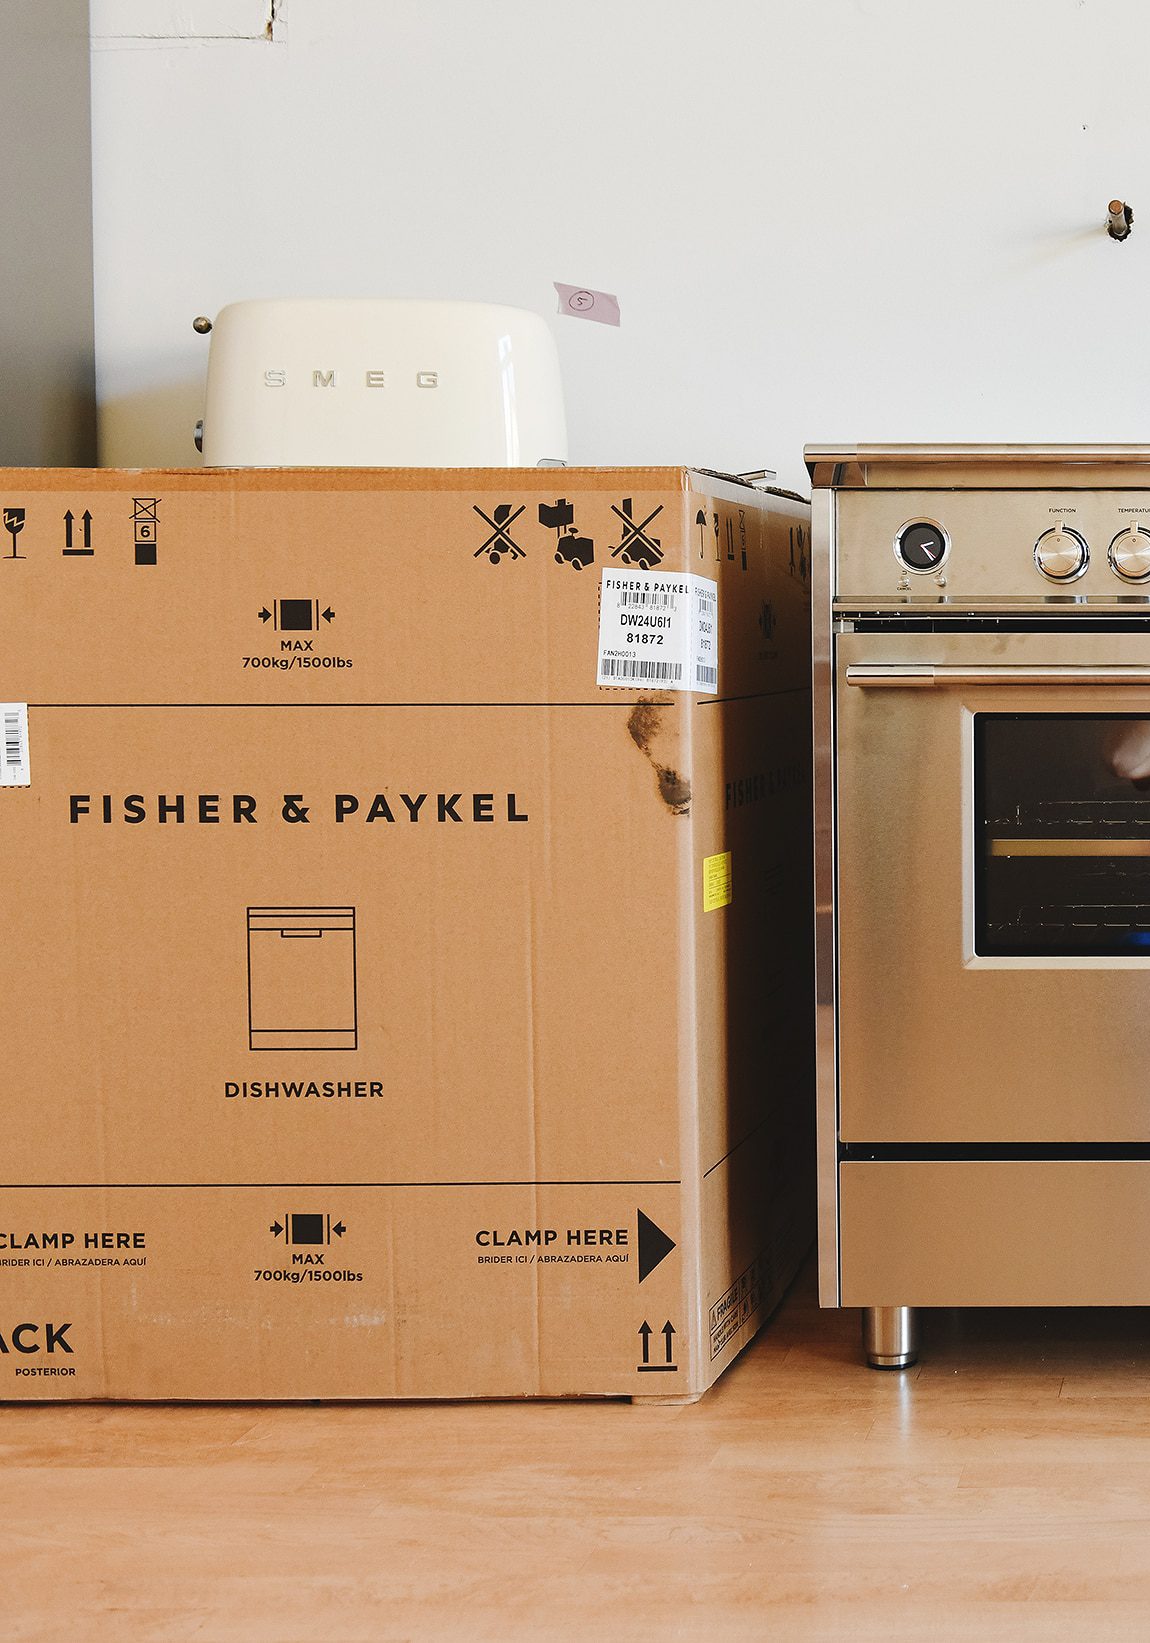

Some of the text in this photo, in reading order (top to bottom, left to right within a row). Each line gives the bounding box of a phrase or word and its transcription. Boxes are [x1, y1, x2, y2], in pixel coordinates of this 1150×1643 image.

[264, 369, 439, 389] SMEG
[140, 525, 150, 538] 6
[606, 580, 641, 591] FISHER
[644, 582, 650, 591] &
[654, 583, 689, 594] PAYKEL
[281, 640, 313, 651] MAX
[626, 633, 664, 645] 81872
[243, 656, 353, 671] 700kg/1500lbs
[70, 794, 529, 823] FISHER & PAYKEL
[224, 1082, 384, 1098] DISHWASHER
[84, 1233, 146, 1249] HERE
[475, 1230, 629, 1246] CLAMP HERE
[0, 1259, 30, 1267] RIDER
[33, 1258, 45, 1266] ICI
[54, 1258, 120, 1266] ABRAZADERA
[123, 1256, 147, 1266] AQUÍ
[291, 1254, 324, 1265] MAX
[477, 1256, 513, 1264] BRIDER
[515, 1255, 527, 1263] ICI
[537, 1255, 602, 1263] ABRAZADERA
[605, 1253, 629, 1263] AQUÍ
[254, 1269, 364, 1284] 700kg/1500lbs
[15, 1367, 76, 1377] POSTERIOR
